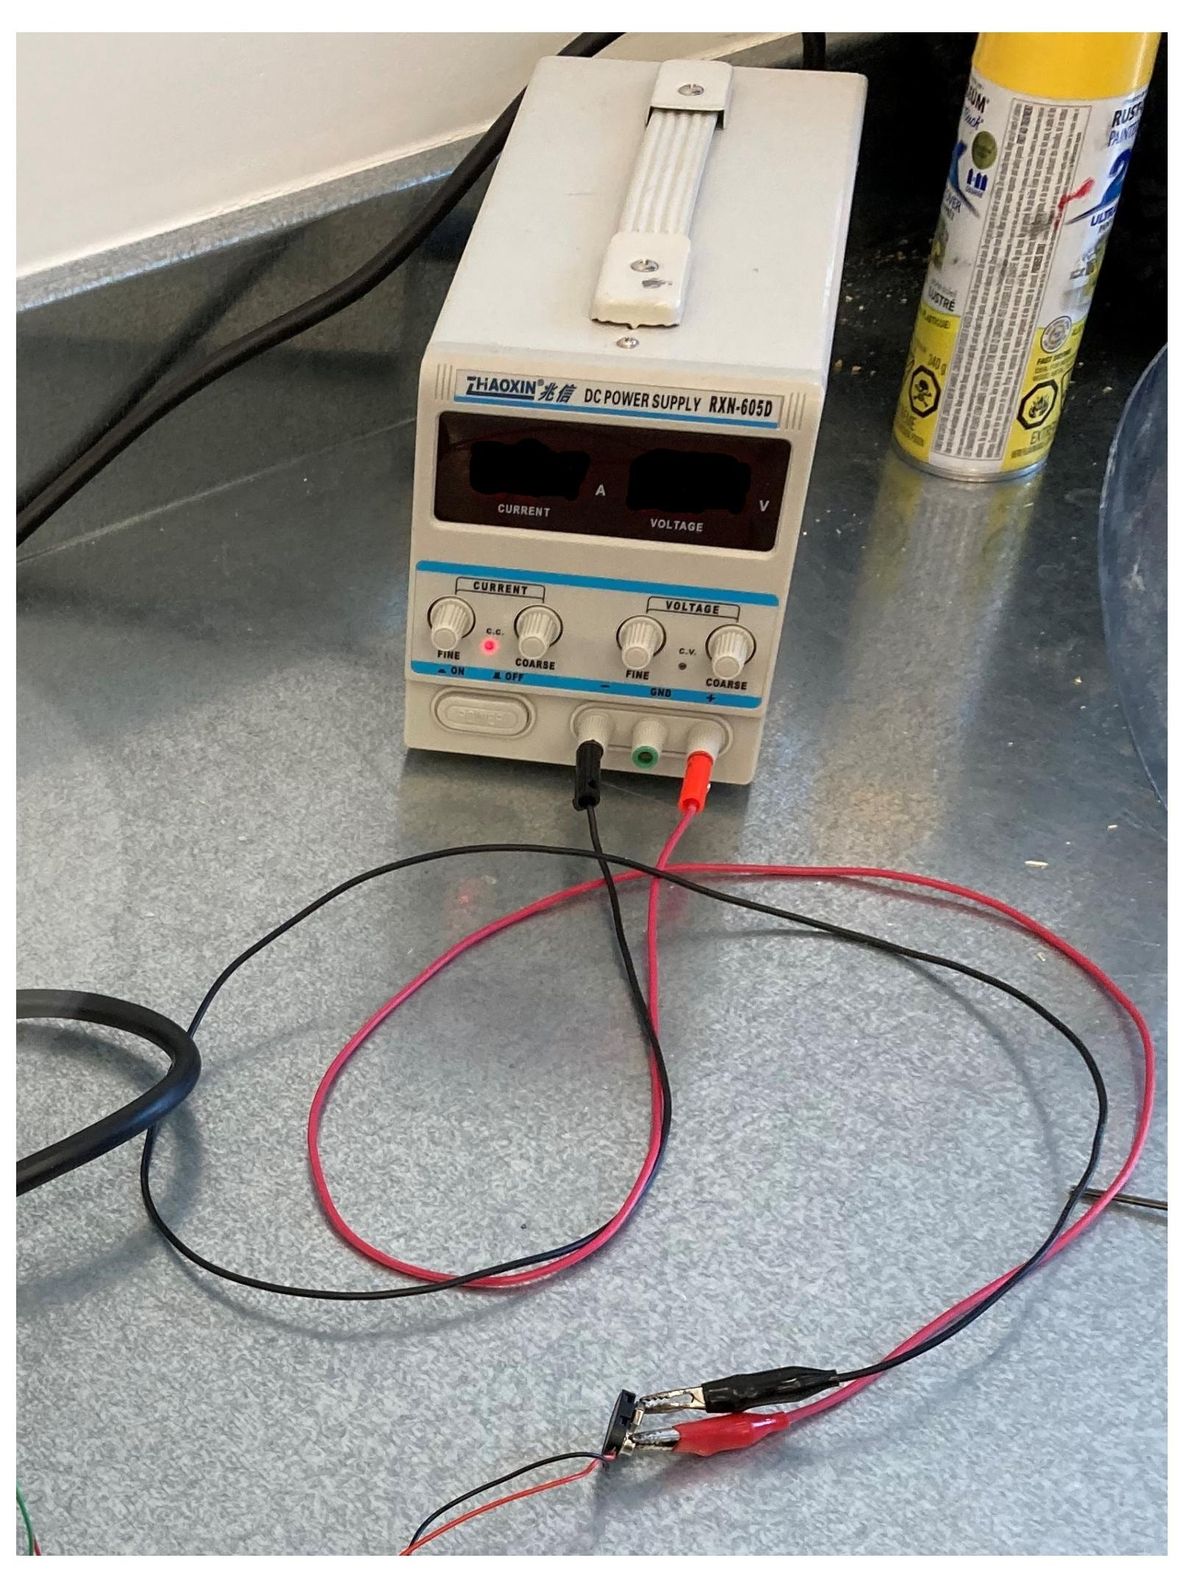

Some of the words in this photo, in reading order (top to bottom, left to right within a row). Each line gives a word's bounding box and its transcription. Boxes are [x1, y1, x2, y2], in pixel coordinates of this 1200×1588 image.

[584, 388, 603, 404] DC
[604, 390, 650, 408] POWER
[652, 393, 702, 412] SUPPLY
[709, 395, 773, 417] RXN-605D
[595, 484, 606, 497] A
[497, 503, 551, 518] CURRENT
[759, 500, 770, 513] V
[650, 518, 704, 533] VOLTAGE
[473, 581, 528, 595] CURRENT
[666, 600, 720, 615] VOLTAGE
[437, 650, 460, 660] FINE
[515, 657, 556, 671] COARSE
[450, 667, 465, 676] ON
[505, 672, 524, 682] OFF
[625, 669, 650, 680] FINE
[705, 678, 748, 691] COARSE
[651, 687, 672, 698] GND
